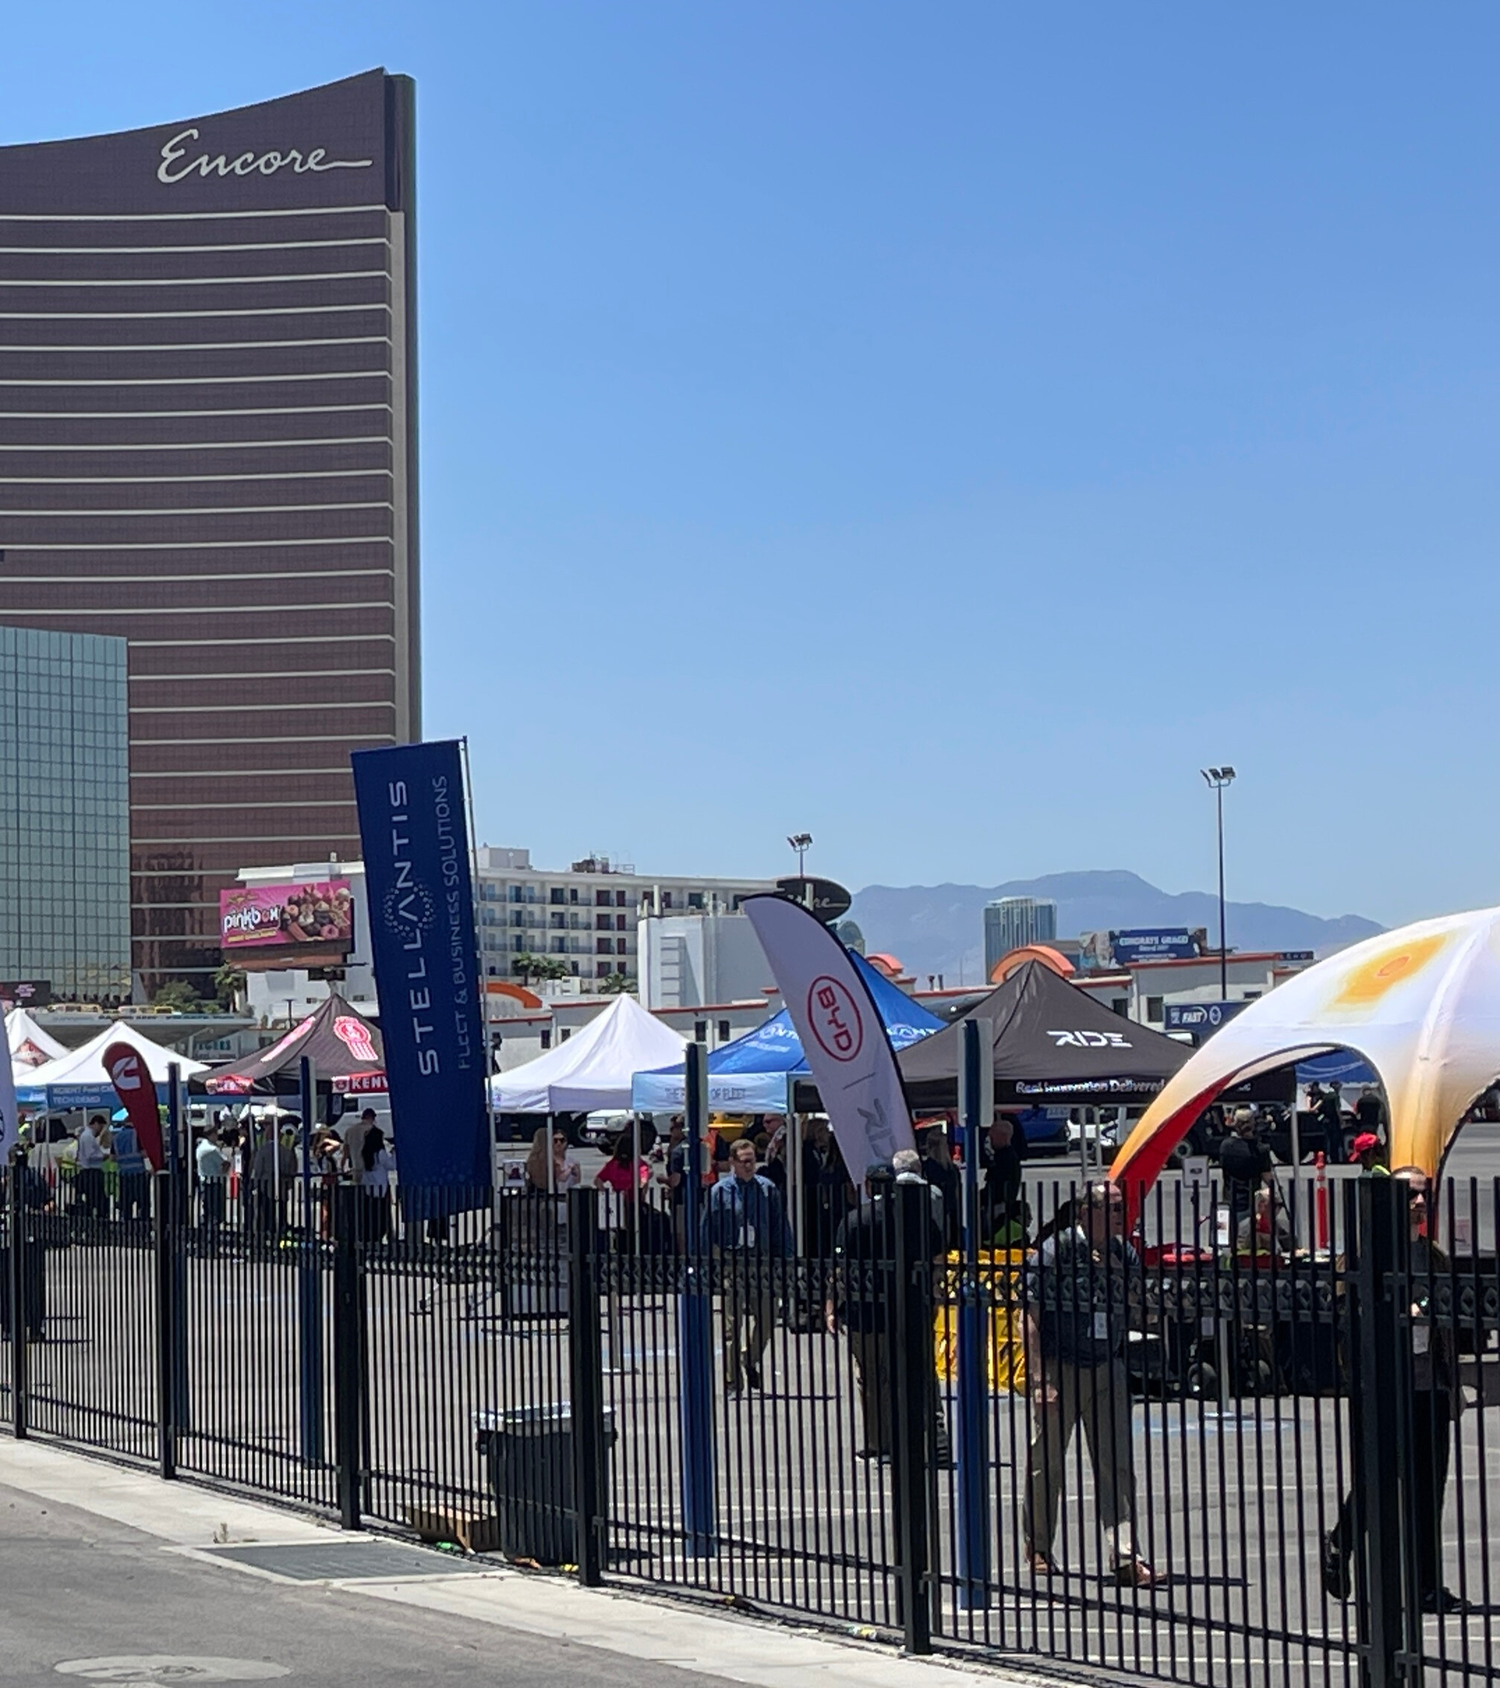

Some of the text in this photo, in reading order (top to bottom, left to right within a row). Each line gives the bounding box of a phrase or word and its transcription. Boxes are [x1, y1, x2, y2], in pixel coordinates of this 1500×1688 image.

[157, 128, 373, 183] Encore
[388, 781, 439, 1076] STELLANTIS
[431, 775, 471, 1070] FLEET & BUSINESS SOLUTIONS
[816, 985, 853, 1051] BYD
[1046, 1030, 1133, 1048] RIDE
